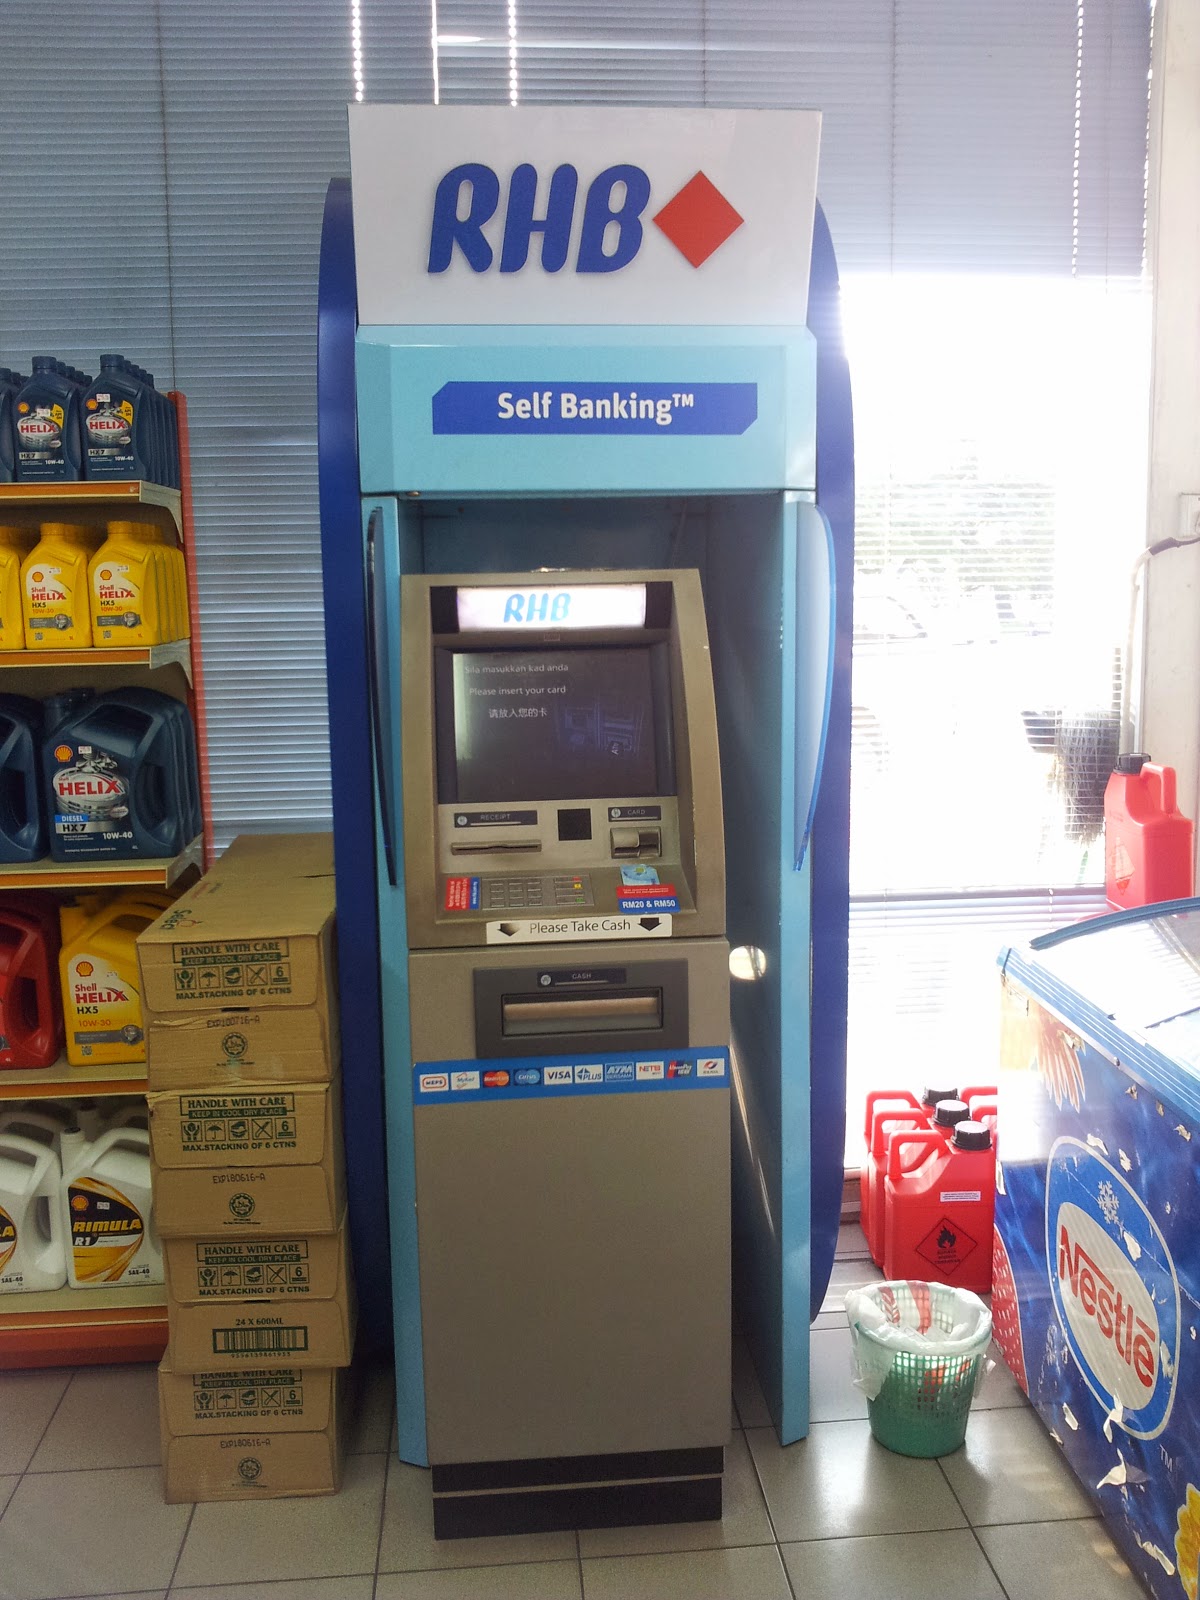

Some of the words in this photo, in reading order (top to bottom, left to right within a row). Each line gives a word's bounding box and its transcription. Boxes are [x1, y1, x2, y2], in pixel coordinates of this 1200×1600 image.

[428, 162, 651, 273] RHB
[498, 392, 552, 419] Self
[21, 425, 56, 433] HELIX
[90, 421, 125, 429] HELIX
[32, 592, 66, 600] HELIX
[100, 590, 135, 598] HELIX
[504, 592, 571, 623] RHB
[483, 665, 526, 673] masukkan
[499, 687, 522, 695] insert
[525, 687, 544, 696] your
[59, 781, 121, 795] HELIX
[530, 922, 568, 934] Please
[571, 920, 598, 932] Take
[602, 919, 630, 931] Cash
[181, 944, 221, 956] HANDLE
[225, 943, 250, 954] WITH
[254, 941, 280, 951] CARE
[276, 966, 283, 977] 6
[572, 972, 592, 980] CASH
[75, 983, 97, 991] Shell
[247, 988, 257, 996] OF
[75, 990, 129, 1004] HELIX
[77, 1006, 98, 1014] HX5
[79, 1019, 111, 1027] 10W-30
[607, 1065, 633, 1074] ATM
[548, 1070, 571, 1080] VISA
[188, 1099, 228, 1109] HANDLE
[232, 1098, 256, 1107] WITH
[259, 1097, 286, 1106] CARE
[282, 1121, 288, 1131] 6
[73, 1219, 141, 1232] RIMULA
[75, 1237, 91, 1245] R1
[204, 1246, 243, 1255] HANDLE
[247, 1246, 271, 1254] WITH
[274, 1244, 299, 1253] CARE
[295, 1267, 302, 1276] 6
[201, 1371, 240, 1379] HANDLE
[289, 1390, 296, 1400] 6
